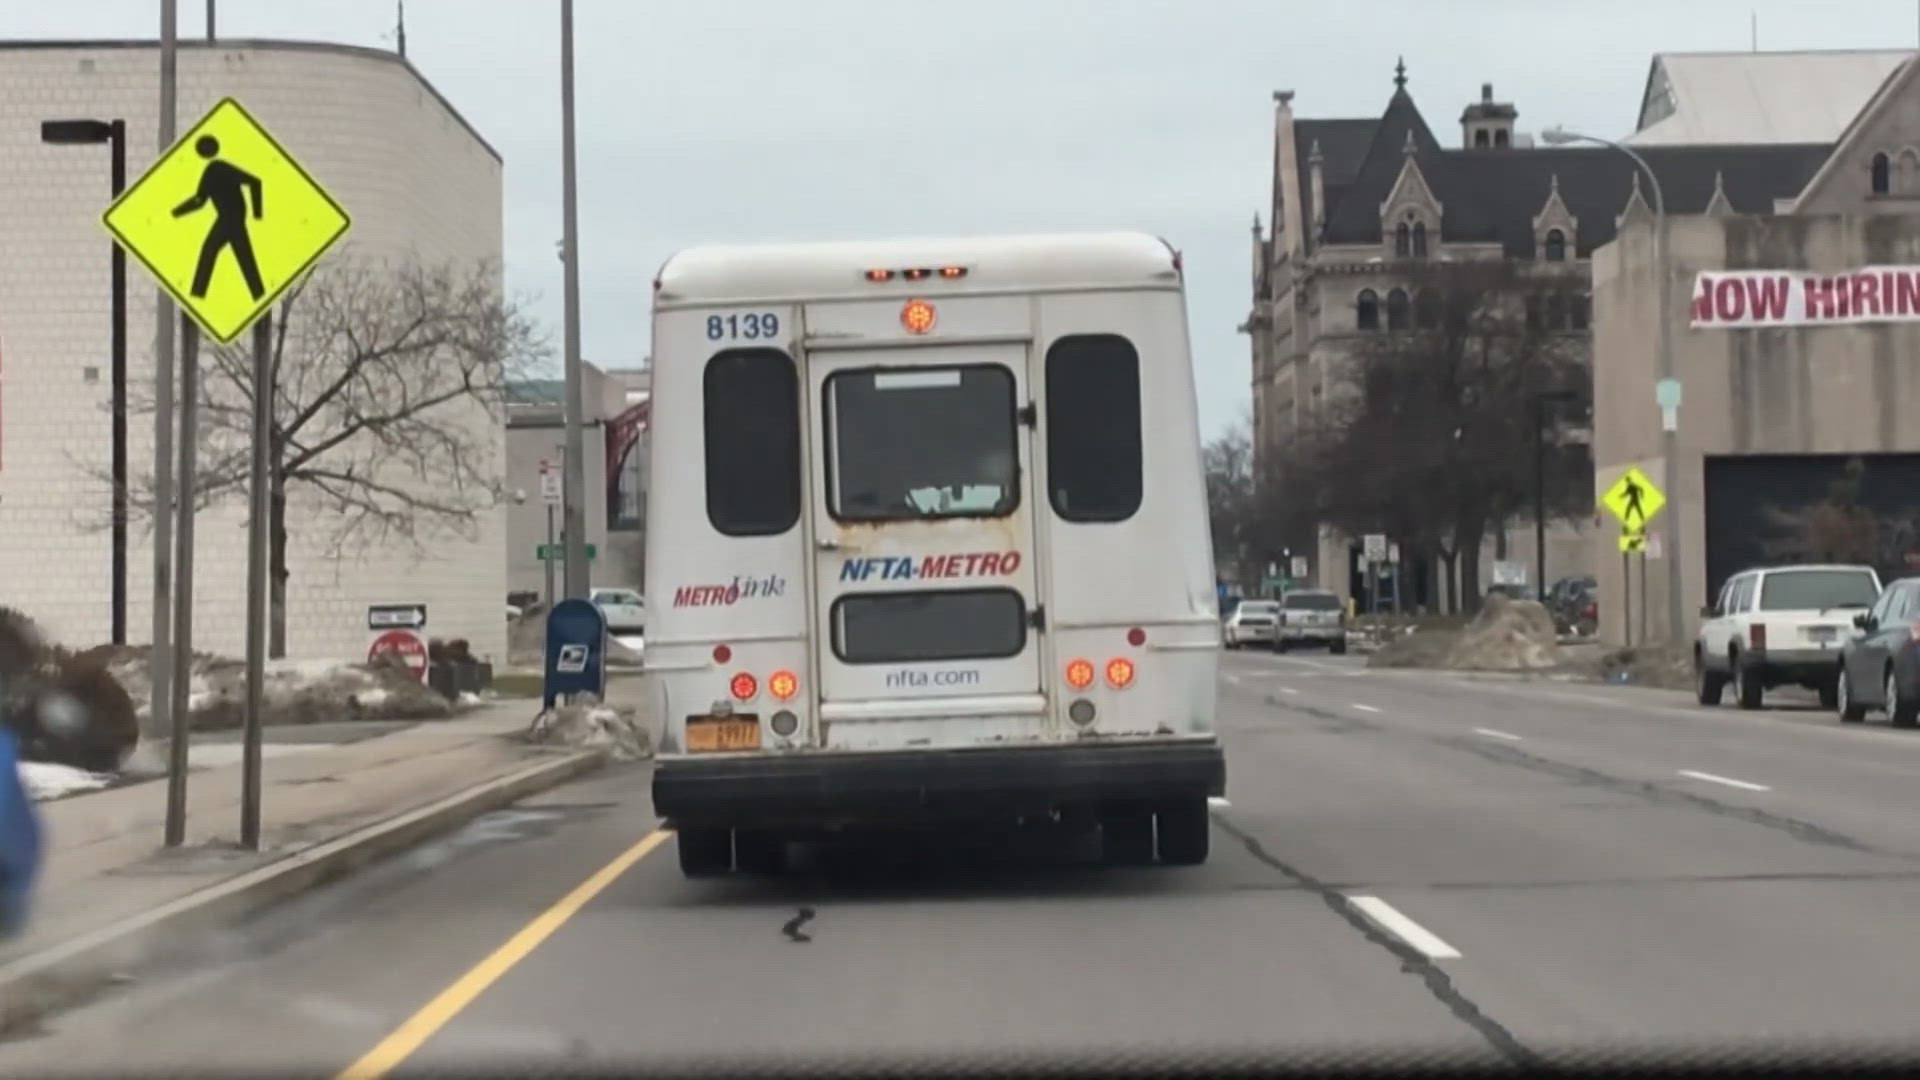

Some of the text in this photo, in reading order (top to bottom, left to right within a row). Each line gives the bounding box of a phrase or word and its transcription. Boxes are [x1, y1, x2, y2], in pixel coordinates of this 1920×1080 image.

[707, 312, 779, 341] 8139
[839, 550, 1022, 582] NFTA-METRO
[886, 669, 980, 688] nftacom
